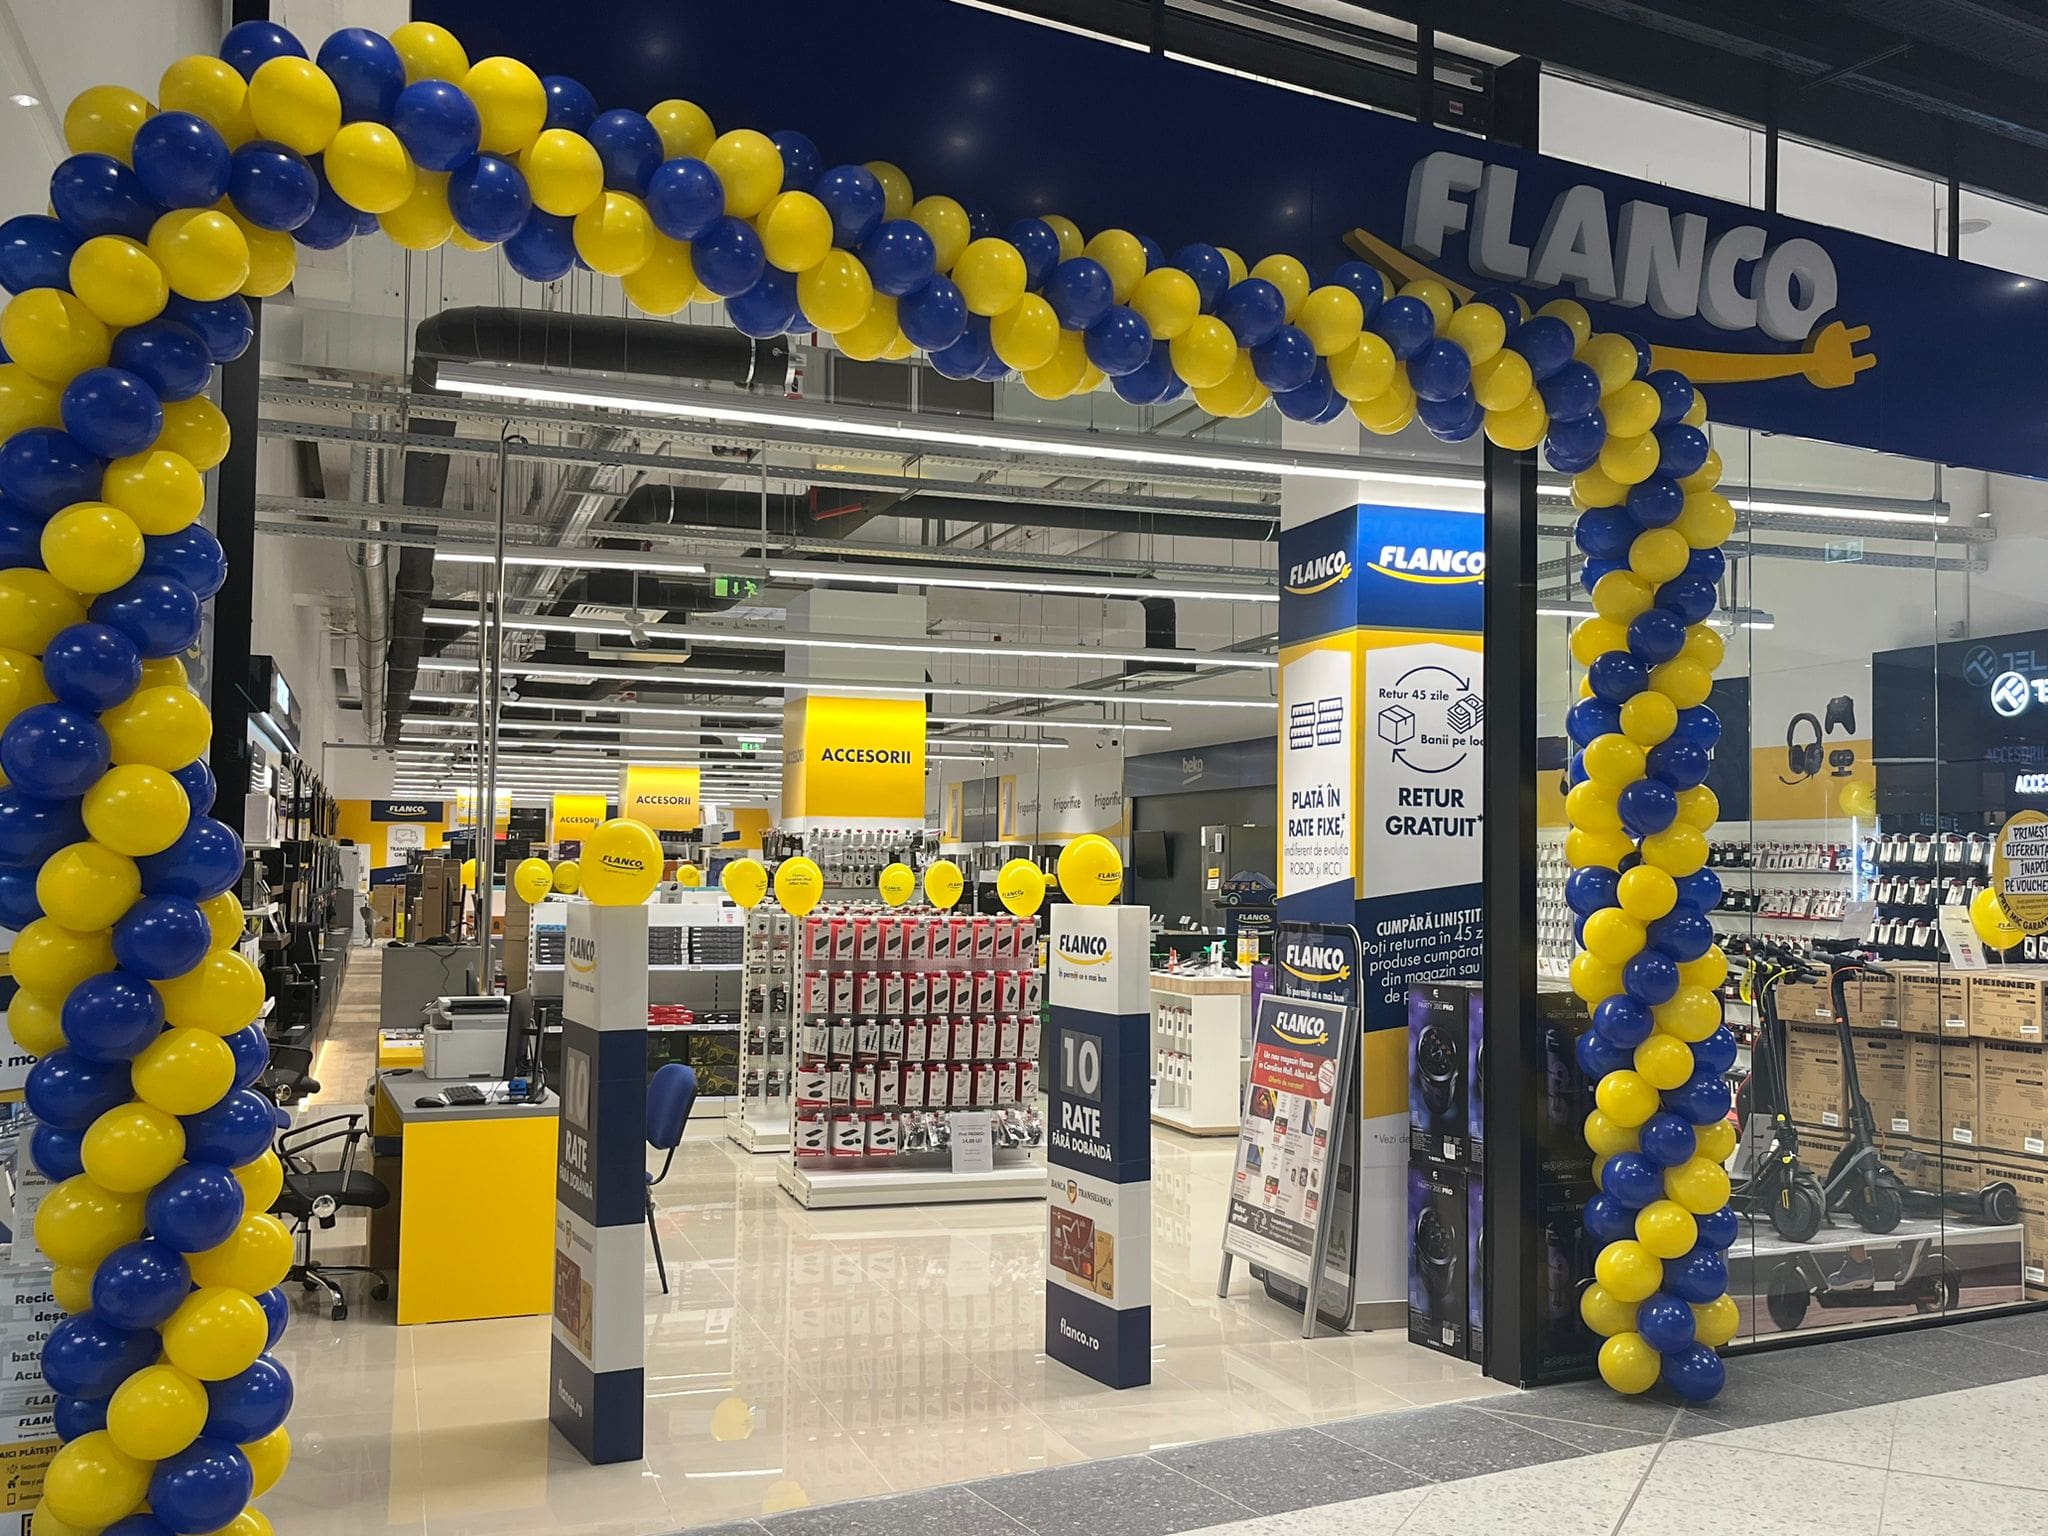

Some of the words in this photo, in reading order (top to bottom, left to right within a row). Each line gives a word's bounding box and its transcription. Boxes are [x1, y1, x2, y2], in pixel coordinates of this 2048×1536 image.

[1401, 151, 1838, 342] FLANCO
[1290, 550, 1346, 586] FLANCO
[1379, 545, 1485, 574] FLANCO
[1379, 688, 1408, 699] Retur
[1412, 690, 1426, 700] 45
[1430, 690, 1449, 701] zile
[1421, 734, 1448, 745] Banii
[1452, 739, 1466, 748] pe
[821, 748, 911, 764] ACCESORII
[1183, 756, 1204, 773] beko
[636, 795, 691, 805] ACCESORII
[1053, 796, 1081, 813] Frigorifice
[1292, 784, 1324, 809] PLATĂ
[1327, 783, 1340, 807] ÎN
[1399, 787, 1464, 808] RETUR
[1017, 800, 1041, 816] Frigorifie
[1289, 818, 1314, 837] RATE
[1285, 842, 1313, 856] indiferent
[1314, 842, 1322, 856] de
[602, 855, 643, 868] FLANCO
[1290, 862, 1314, 875] ROBOR
[2005, 879, 2015, 892] PE
[1376, 911, 1433, 936] CUMPĂRĂ
[570, 937, 595, 961] FLANCO
[1060, 934, 1107, 955] FLANCO
[1363, 940, 1386, 958] Poți
[1389, 937, 1436, 952] returna
[1440, 931, 1451, 944] în
[1454, 926, 1472, 941] 45
[1286, 945, 1344, 971] FLANCO
[1370, 953, 1421, 976] produse
[1381, 971, 1401, 987] din
[1405, 964, 1456, 981] magazin
[1460, 963, 1480, 975] sau
[1903, 975, 1961, 986] HEINER
[1973, 977, 2036, 990] HEINNER
[1384, 988, 1400, 1004] de
[1276, 1011, 1325, 1037] FLANCO
[1064, 1036, 1099, 1094] 10
[568, 1055, 589, 1122] 10
[1062, 1101, 1100, 1138] RATE
[565, 1129, 588, 1173] RATE
[1052, 1129, 1071, 1149] FĂRĂ
[1072, 1138, 1112, 1162] DOBÂNDĂ
[1986, 1168, 2044, 1184] HEINNER
[1051, 1179, 1066, 1192] BANCA
[1078, 1188, 1112, 1207] TRANSILVANIA
[1102, 1281, 1112, 1291] VISA
[1060, 1317, 1099, 1350] flanco.ro
